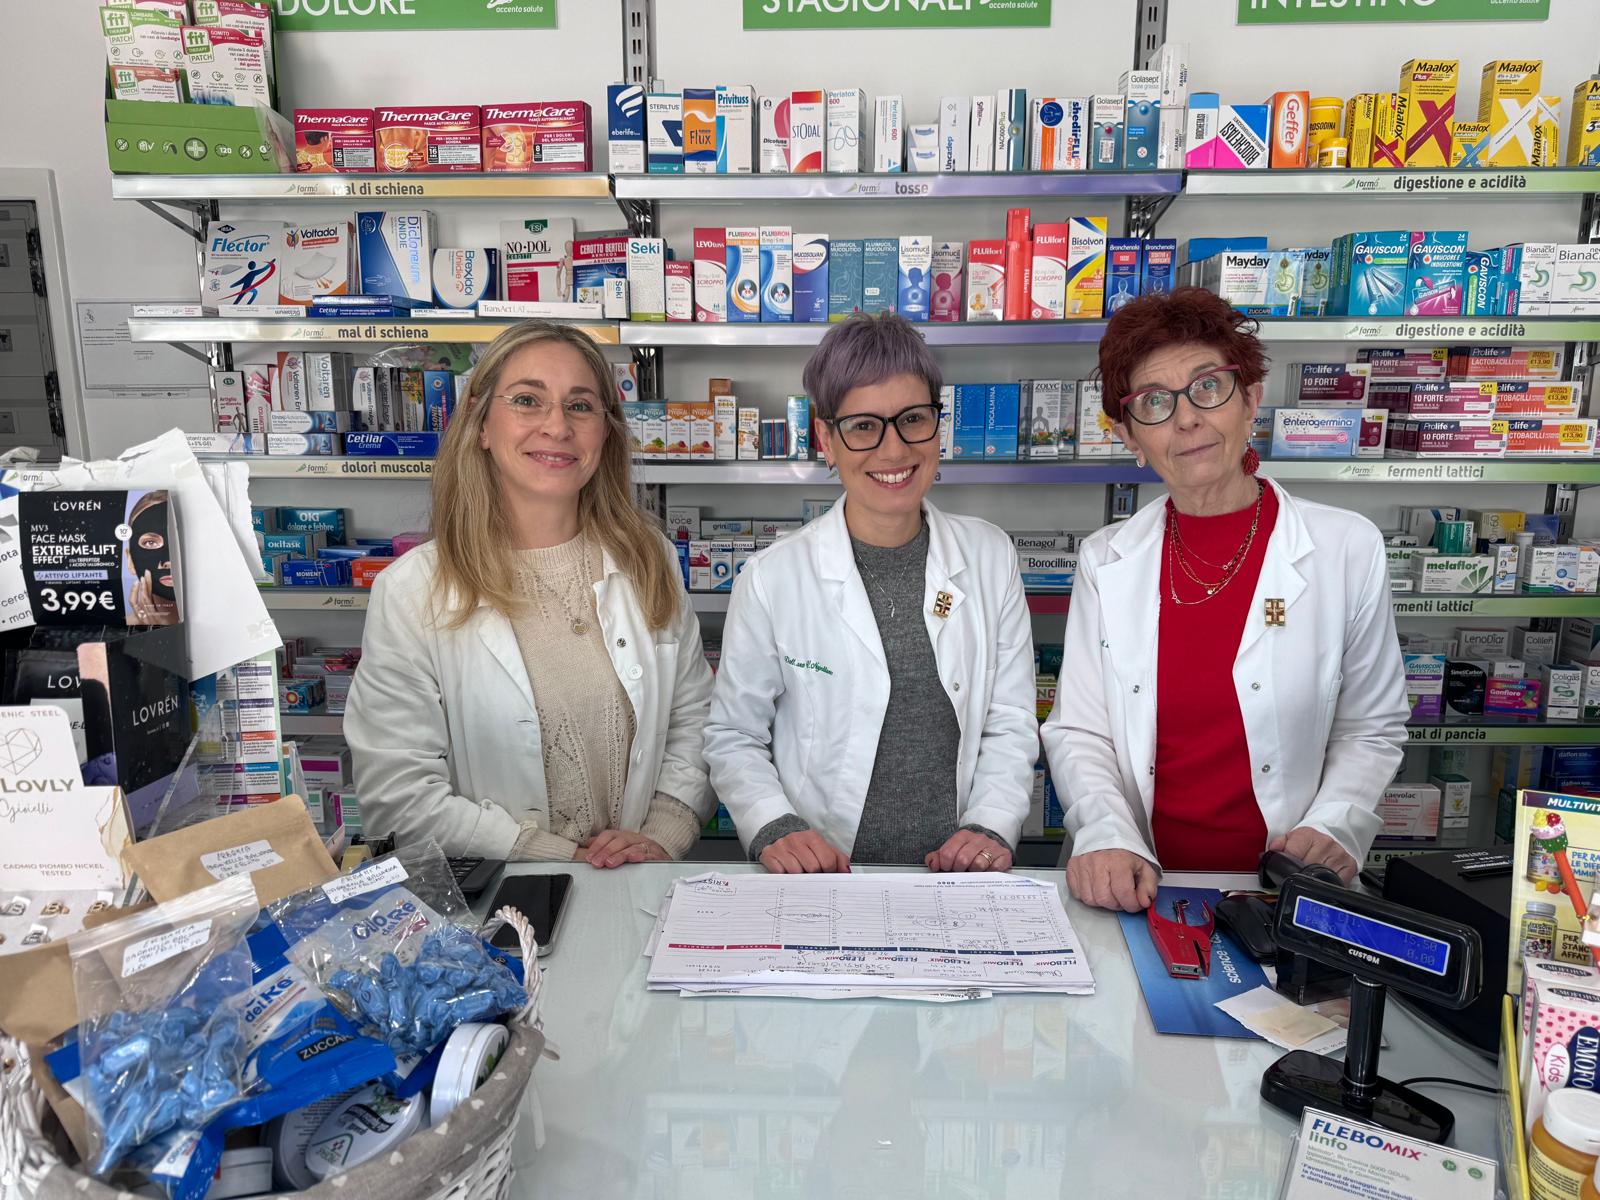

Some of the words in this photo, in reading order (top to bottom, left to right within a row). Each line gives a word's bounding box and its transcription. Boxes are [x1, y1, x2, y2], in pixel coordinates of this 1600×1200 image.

[191, 54, 213, 62] PATCH
[1416, 61, 1457, 73] Maalox
[1498, 61, 1541, 73] Maalox
[1131, 75, 1159, 85] Golasept
[717, 93, 749, 106] Privituss
[1096, 97, 1124, 106] Golasept
[379, 111, 473, 122] ThermaCare
[486, 107, 577, 120] ThermaCare
[1396, 96, 1408, 141] Maalox
[297, 114, 369, 126] ThermaCare
[1285, 98, 1300, 148] Geffer
[611, 128, 634, 137] eberlife
[1455, 123, 1490, 133] Maalox
[1220, 121, 1260, 166] BIOCHETASI
[1531, 124, 1544, 167] Maalox
[359, 182, 371, 195] di
[375, 182, 424, 195] schiena
[895, 182, 929, 194] tosse
[1393, 175, 1464, 192] digestione
[1468, 179, 1476, 189] e
[1480, 175, 1527, 189] acidità
[300, 226, 338, 240] Voltadol
[398, 216, 408, 249] UNIDIE
[212, 235, 267, 253] Flector
[1071, 237, 1104, 247] Bisolvon
[630, 242, 661, 255] Seki
[1355, 245, 1405, 255] GAVISCON
[1413, 244, 1465, 255] GAVISCON
[1525, 246, 1555, 254] Bianacid
[1559, 250, 1600, 261] Bianac
[1225, 256, 1270, 269] Mayday
[465, 250, 475, 296] Brexidol
[1478, 257, 1490, 309] GAVISCON
[615, 280, 623, 299] Seki
[338, 326, 363, 339] mal
[365, 325, 377, 339] di
[381, 326, 429, 340] schiena
[1395, 323, 1465, 340] digestione
[1468, 327, 1476, 337] e
[1481, 323, 1526, 337] acidità
[1472, 348, 1499, 357] Prolife
[1471, 358, 1515, 366] LACTOBACILLI
[1303, 365, 1333, 375] Prolife
[321, 355, 330, 399] Voltaren
[1303, 378, 1313, 386] 10
[1314, 378, 1339, 386] FORTE
[1414, 384, 1439, 392] Prolife
[1414, 394, 1422, 402] 10
[1423, 394, 1444, 402] FORTE
[1283, 416, 1353, 428] enterogermina
[1423, 423, 1448, 431] Prolife
[346, 433, 385, 443] Cetilar
[1422, 433, 1431, 441] 10
[1432, 433, 1454, 441] FORTE
[341, 461, 377, 474] dolori
[1388, 465, 1443, 479] fermenti
[1446, 465, 1485, 479] lattici
[669, 517, 692, 525] voce
[31, 534, 56, 543] FACE
[58, 534, 87, 543] MASK
[1017, 538, 1056, 549] Benagol
[32, 544, 117, 557] EXTREME-LIFT
[32, 555, 64, 565] EFFECT
[1028, 557, 1078, 568] Borocillina
[1426, 560, 1479, 571] melaflor
[40, 588, 116, 615] 3,99€
[1436, 599, 1474, 613] lattici
[1490, 688, 1521, 698] Gonfiore
[1430, 729, 1442, 740] di
[1444, 729, 1487, 742] pancia
[1562, 934, 1580, 944] PER
[1348, 947, 1381, 966] CUSTOM
[1547, 1053, 1565, 1083] Kids
[1308, 1131, 1348, 1152] linfo
[1312, 1118, 1422, 1161] FLEBOMIX
